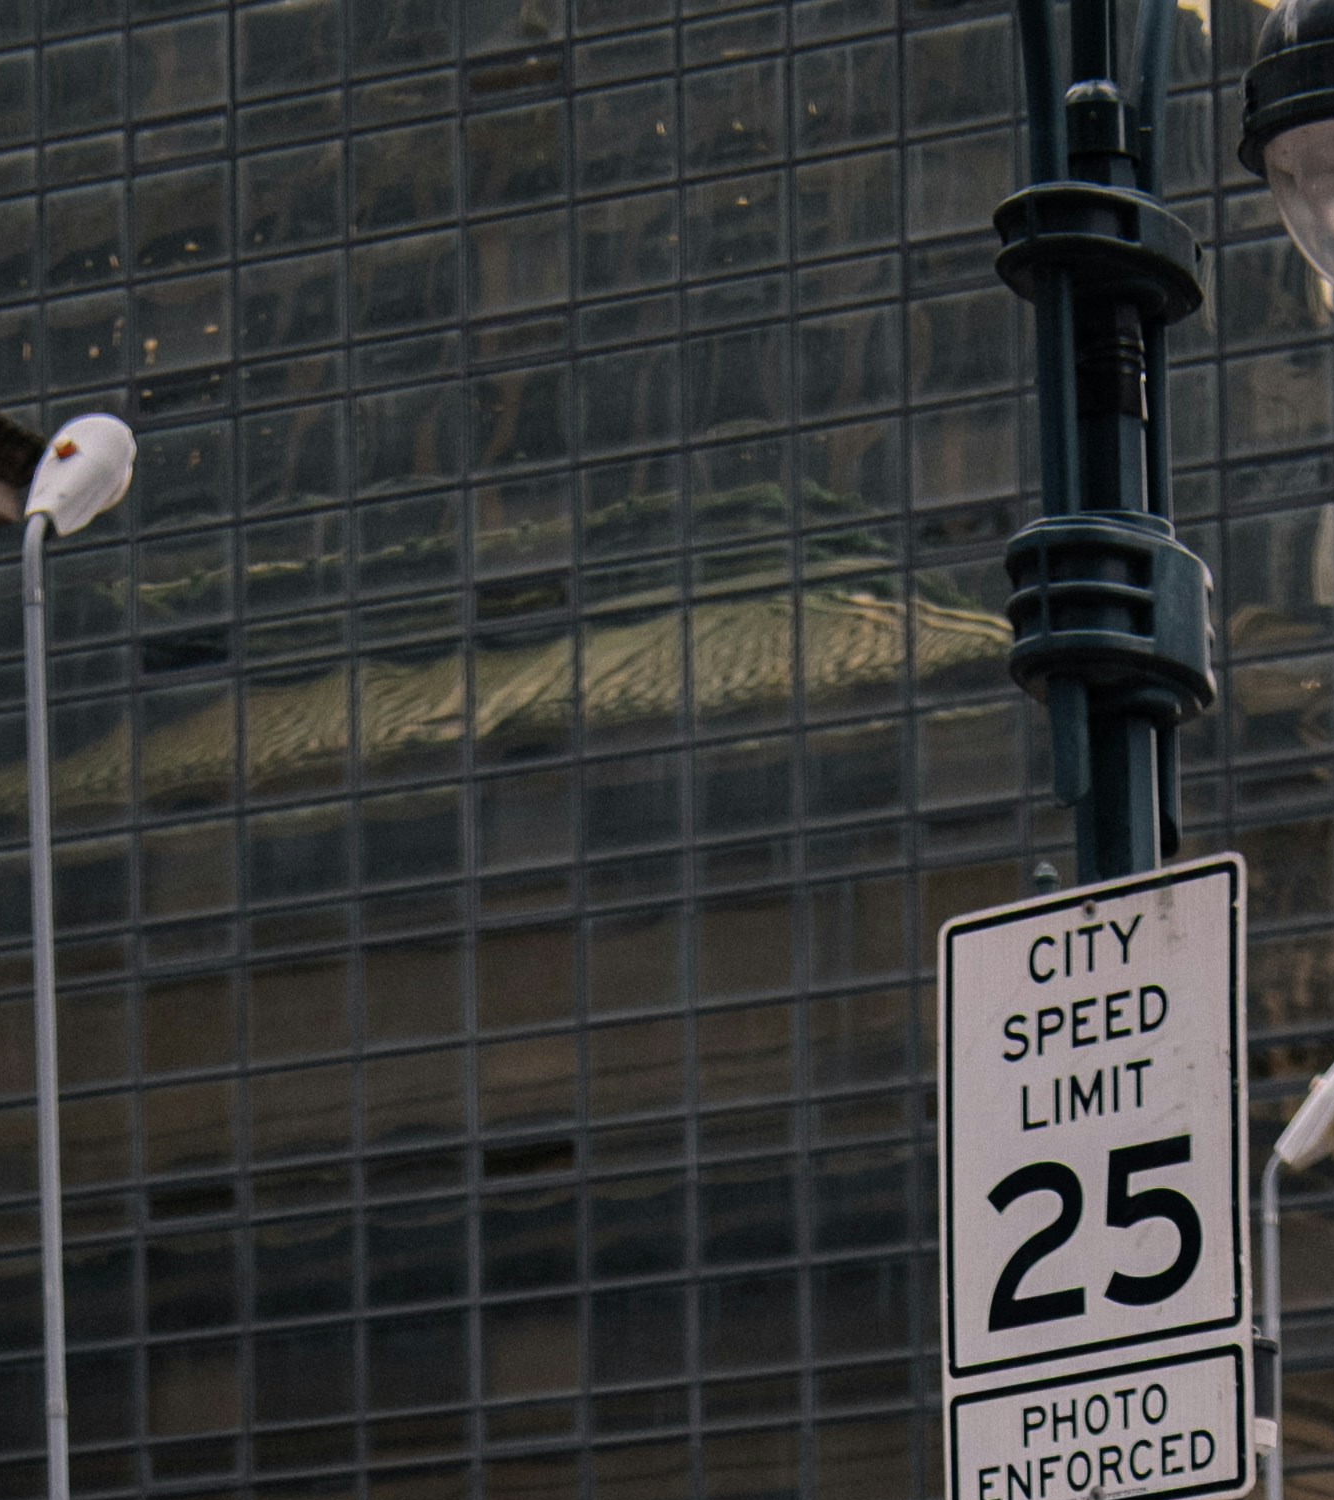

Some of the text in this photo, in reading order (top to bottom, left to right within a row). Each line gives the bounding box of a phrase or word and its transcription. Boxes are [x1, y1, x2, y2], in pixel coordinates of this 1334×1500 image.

[1029, 914, 1143, 984] CITY
[1002, 985, 1169, 1062] SPEED
[1021, 1059, 1153, 1131] LIMIT
[987, 1134, 1203, 1333] 25
[1023, 1383, 1169, 1448] PHOTO
